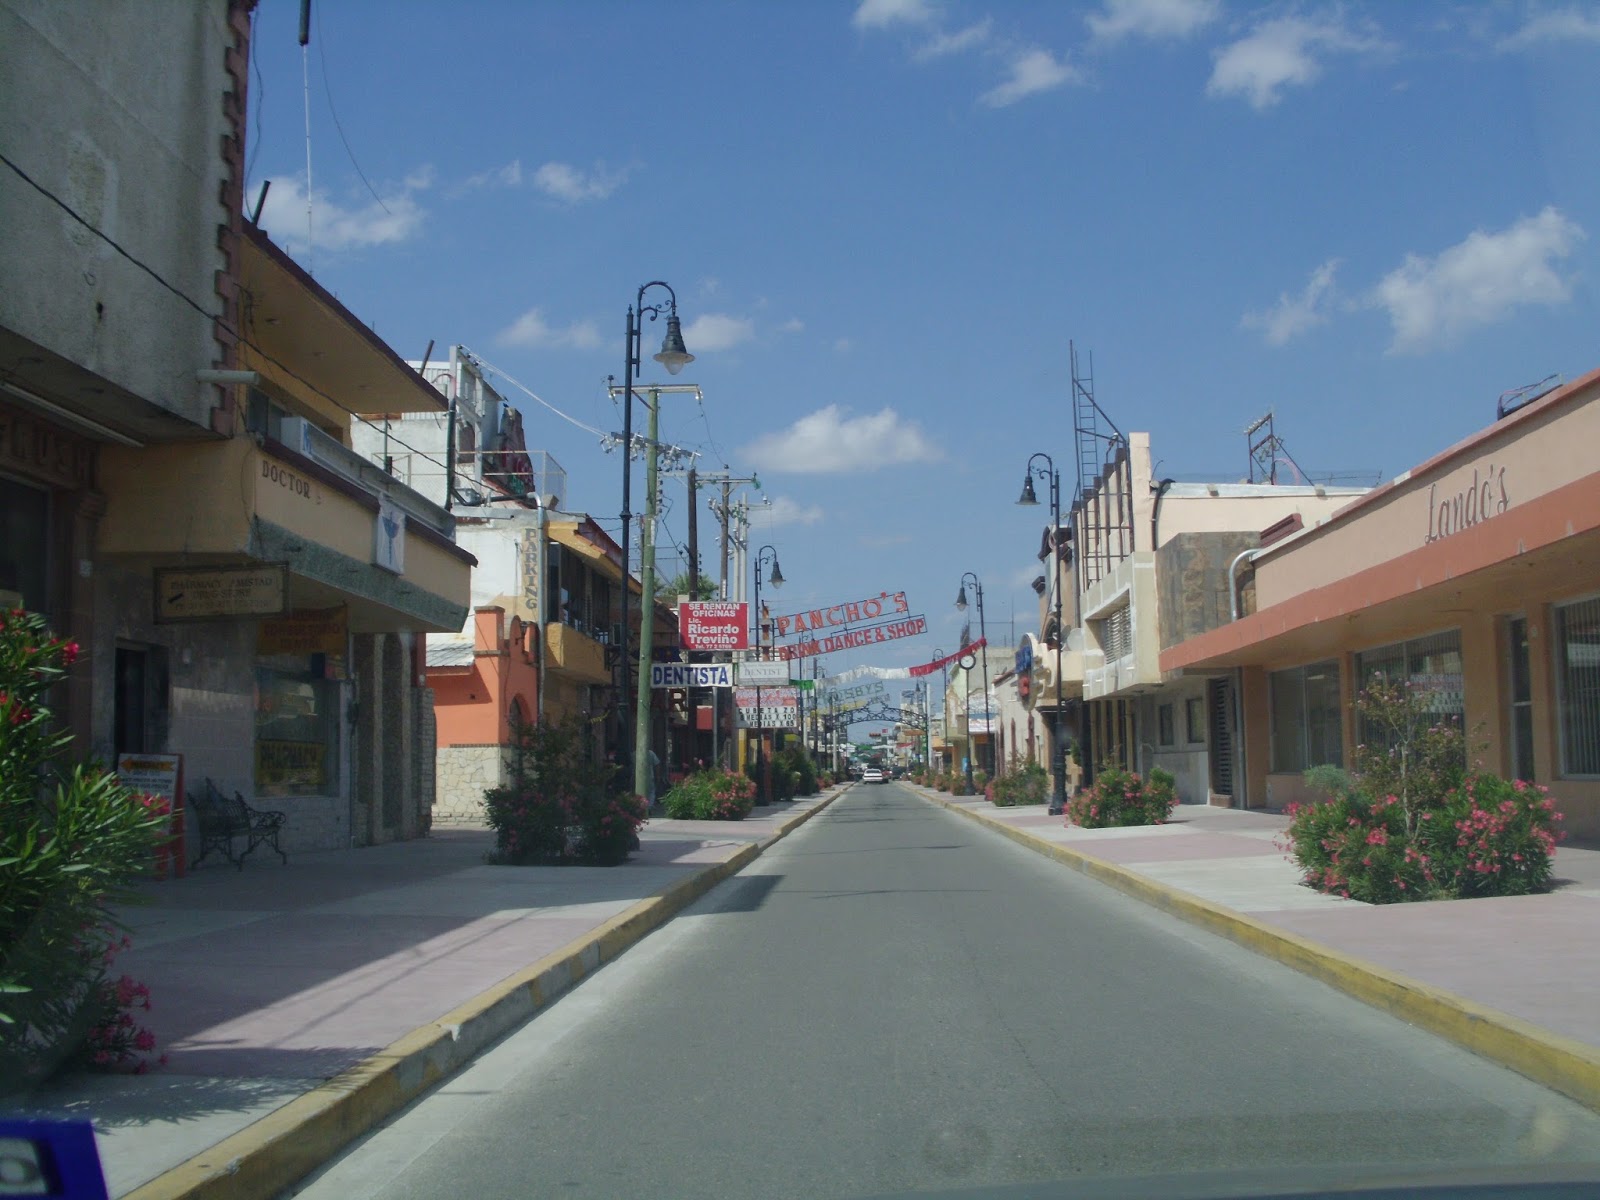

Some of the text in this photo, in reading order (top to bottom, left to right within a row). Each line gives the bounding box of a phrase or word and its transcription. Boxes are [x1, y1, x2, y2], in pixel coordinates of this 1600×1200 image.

[262, 460, 310, 499] DOCTOR
[1424, 464, 1510, 544] Lando's
[525, 528, 538, 609] PARKING
[688, 624, 739, 634] Ricardo
[777, 591, 908, 636] PANCHO'S
[688, 634, 738, 644] Treviño
[779, 618, 925, 661] DRINK DANCE & SHOP
[653, 666, 729, 685] DENTISTA
[744, 668, 781, 676] DENTIST
